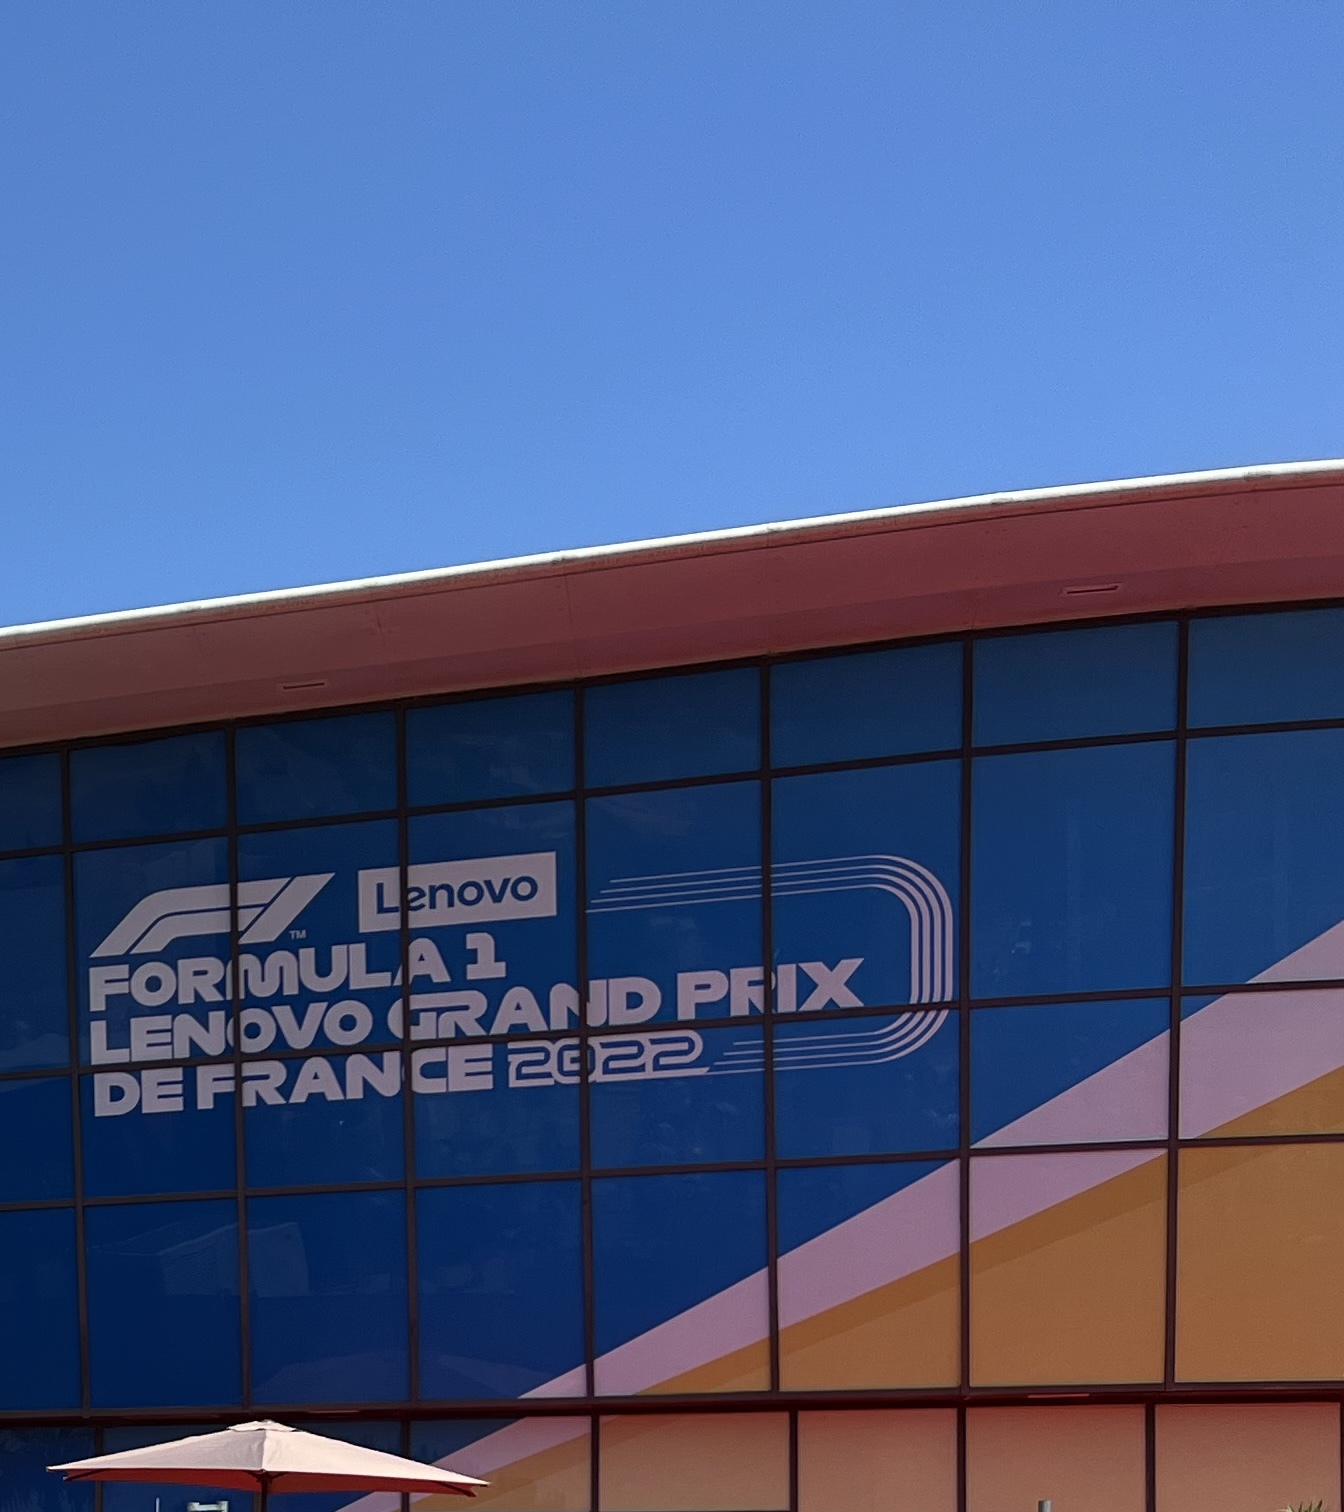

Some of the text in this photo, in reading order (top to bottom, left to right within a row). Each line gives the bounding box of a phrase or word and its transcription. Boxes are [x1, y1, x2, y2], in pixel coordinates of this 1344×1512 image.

[376, 875, 539, 915] Lenovo
[88, 931, 507, 1013] FORMULA 1
[89, 957, 865, 1066] LENOVO GRAND PRIX
[93, 1028, 711, 1118] DE FRANCE 2022
